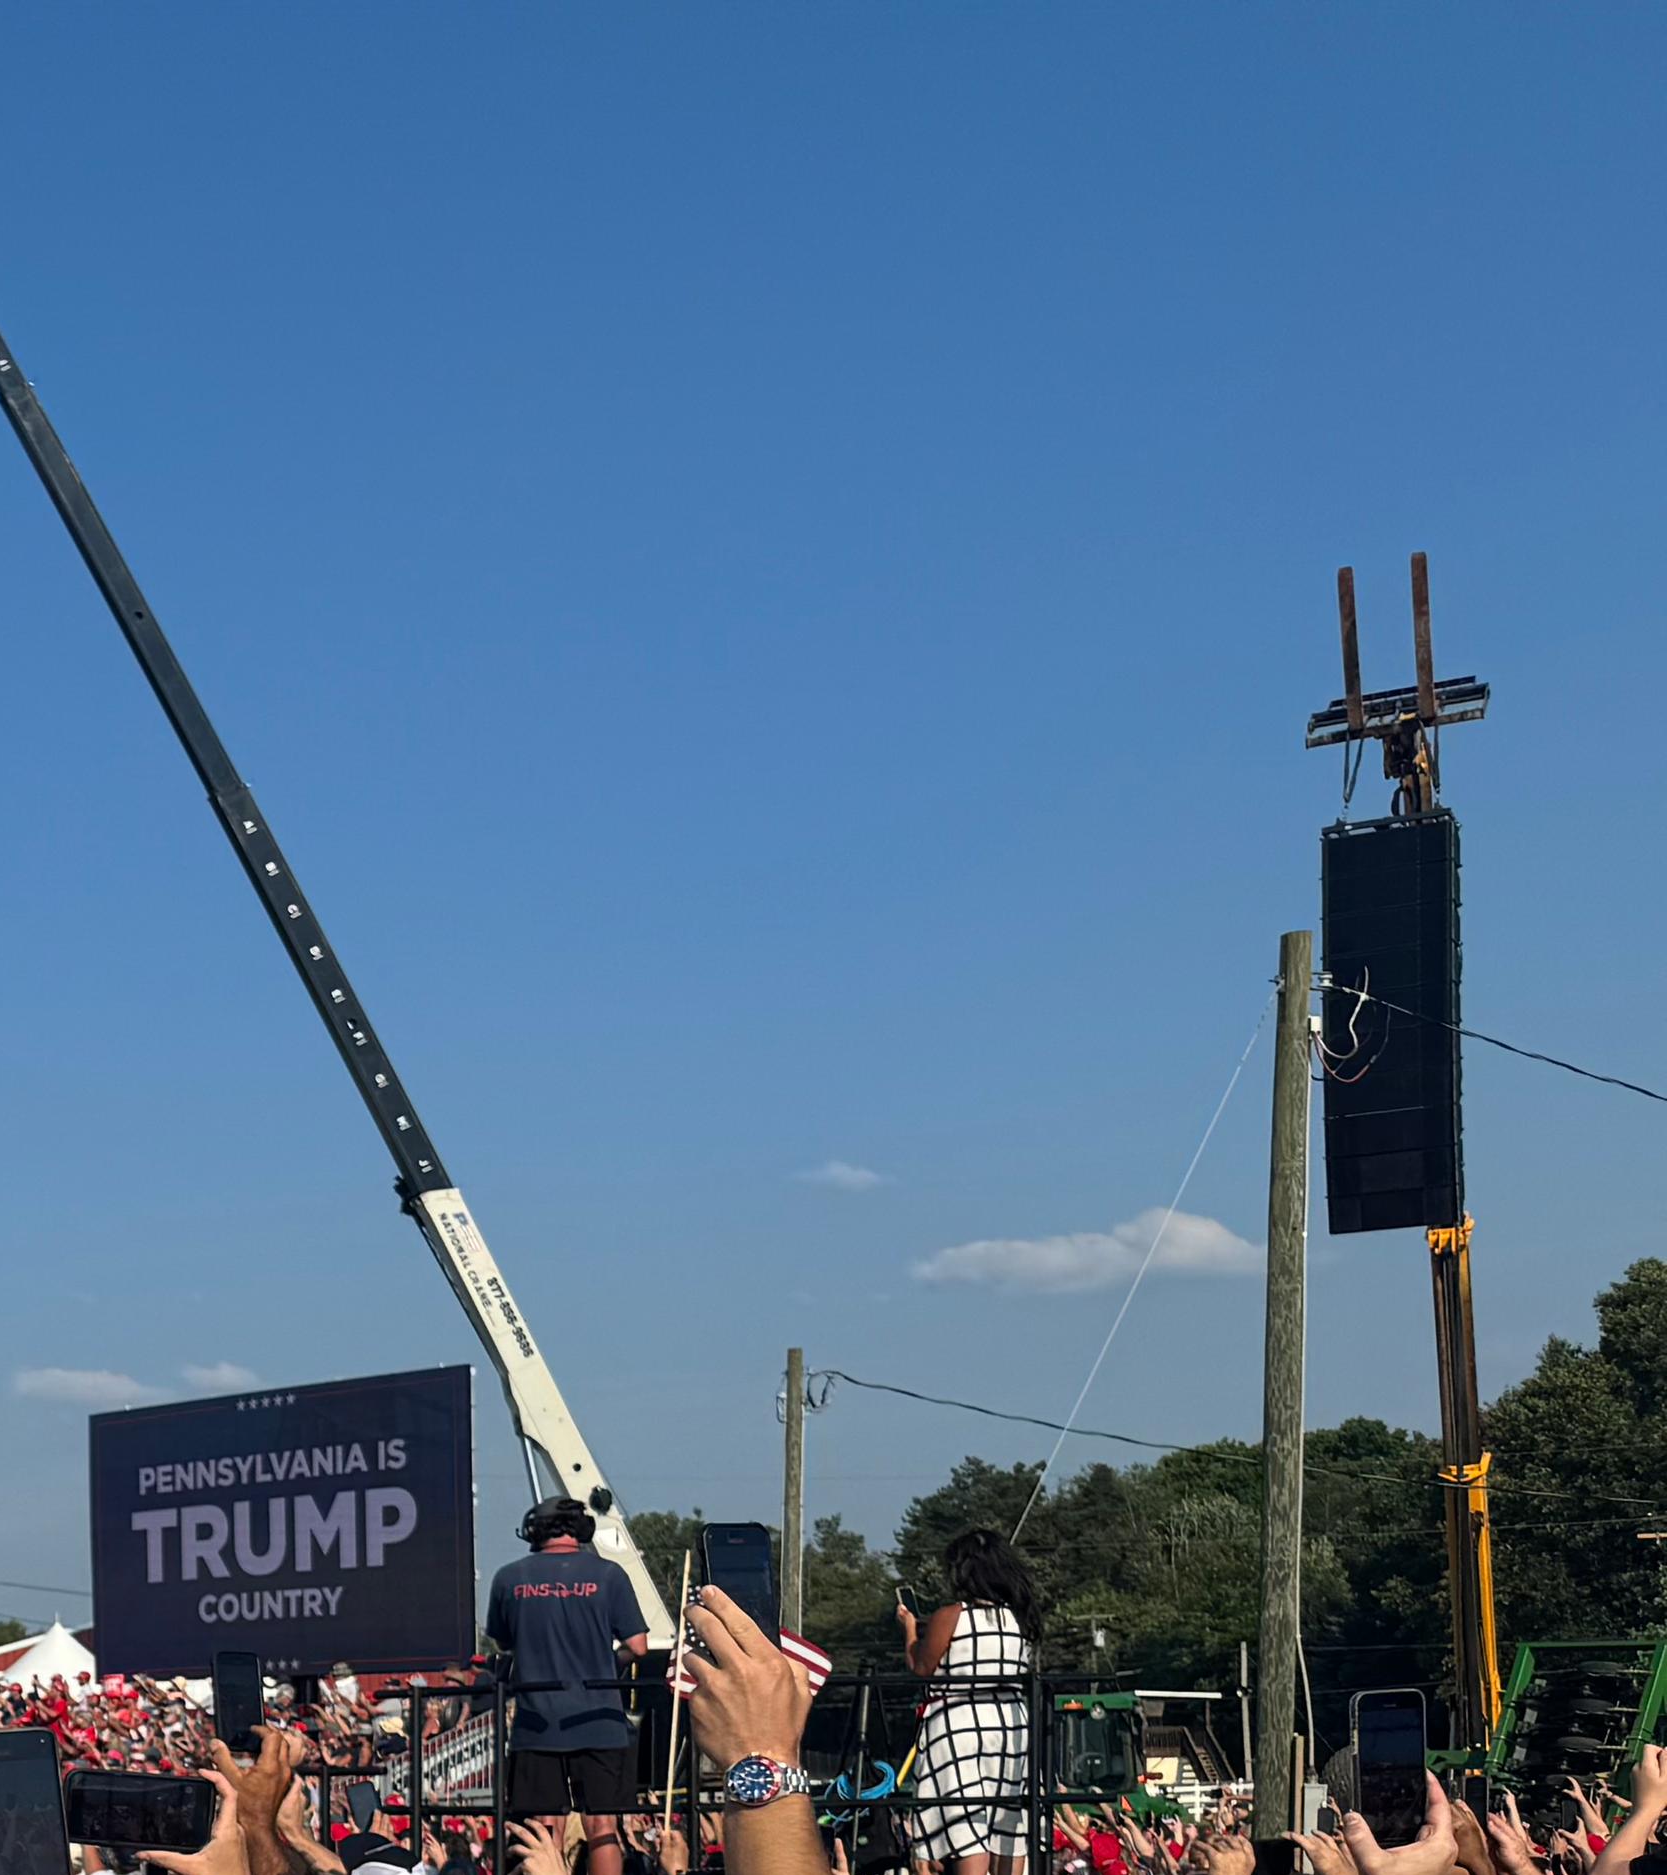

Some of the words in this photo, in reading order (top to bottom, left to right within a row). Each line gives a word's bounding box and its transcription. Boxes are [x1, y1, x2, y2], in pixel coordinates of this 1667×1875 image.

[139, 1442, 367, 1496] PENNSYLVANIA
[377, 1439, 406, 1471] IS
[131, 1487, 417, 1583] TRUMP
[198, 1586, 343, 1623] COUNTRY
[573, 1582, 598, 1597] UP
